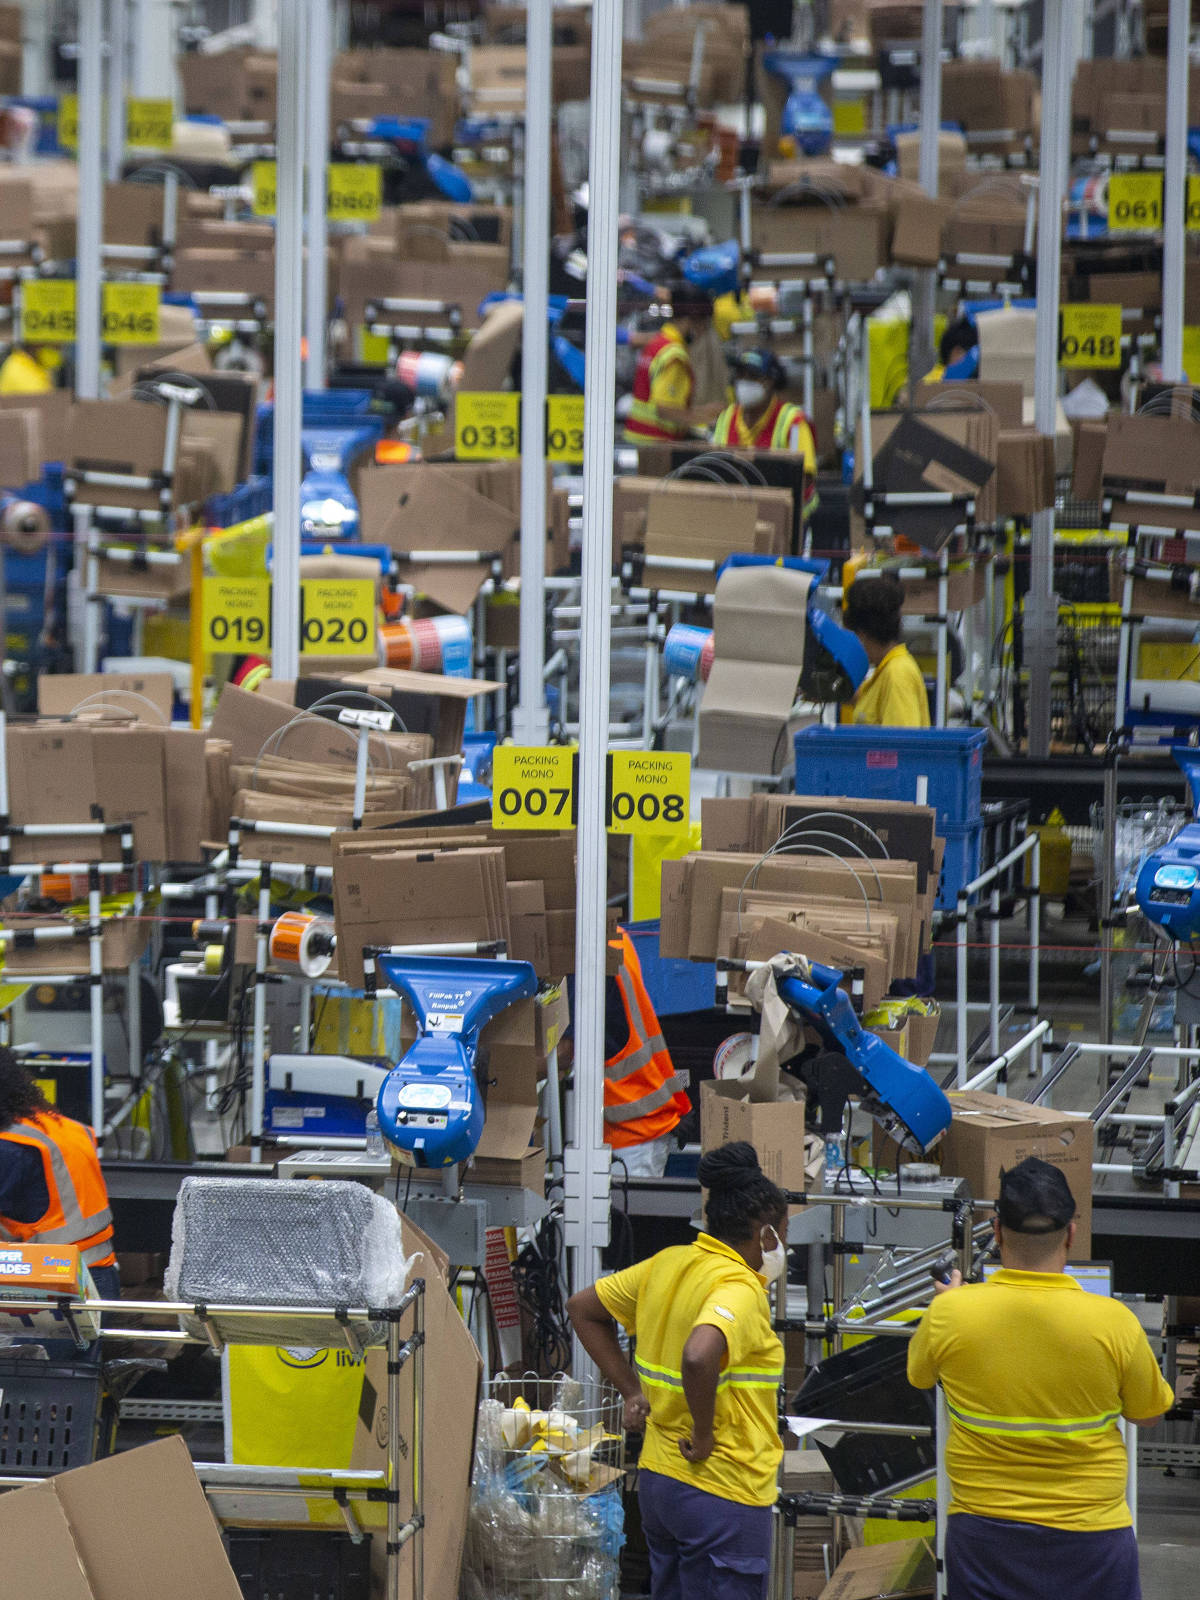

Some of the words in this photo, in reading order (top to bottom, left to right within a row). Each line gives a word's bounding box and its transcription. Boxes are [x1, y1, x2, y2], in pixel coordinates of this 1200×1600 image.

[1115, 201, 1159, 220] 061
[1062, 335, 1116, 358] 048
[461, 425, 515, 449] 033
[549, 429, 584, 451] 03
[210, 615, 265, 642] 019
[303, 618, 368, 643] 020
[514, 755, 560, 766] PACKING
[628, 759, 673, 771] PACKING
[521, 769, 554, 779] MONO
[635, 774, 668, 784] MONO
[499, 788, 570, 816] 007
[612, 792, 685, 822] 008
[722, 1105, 730, 1140] Trident
